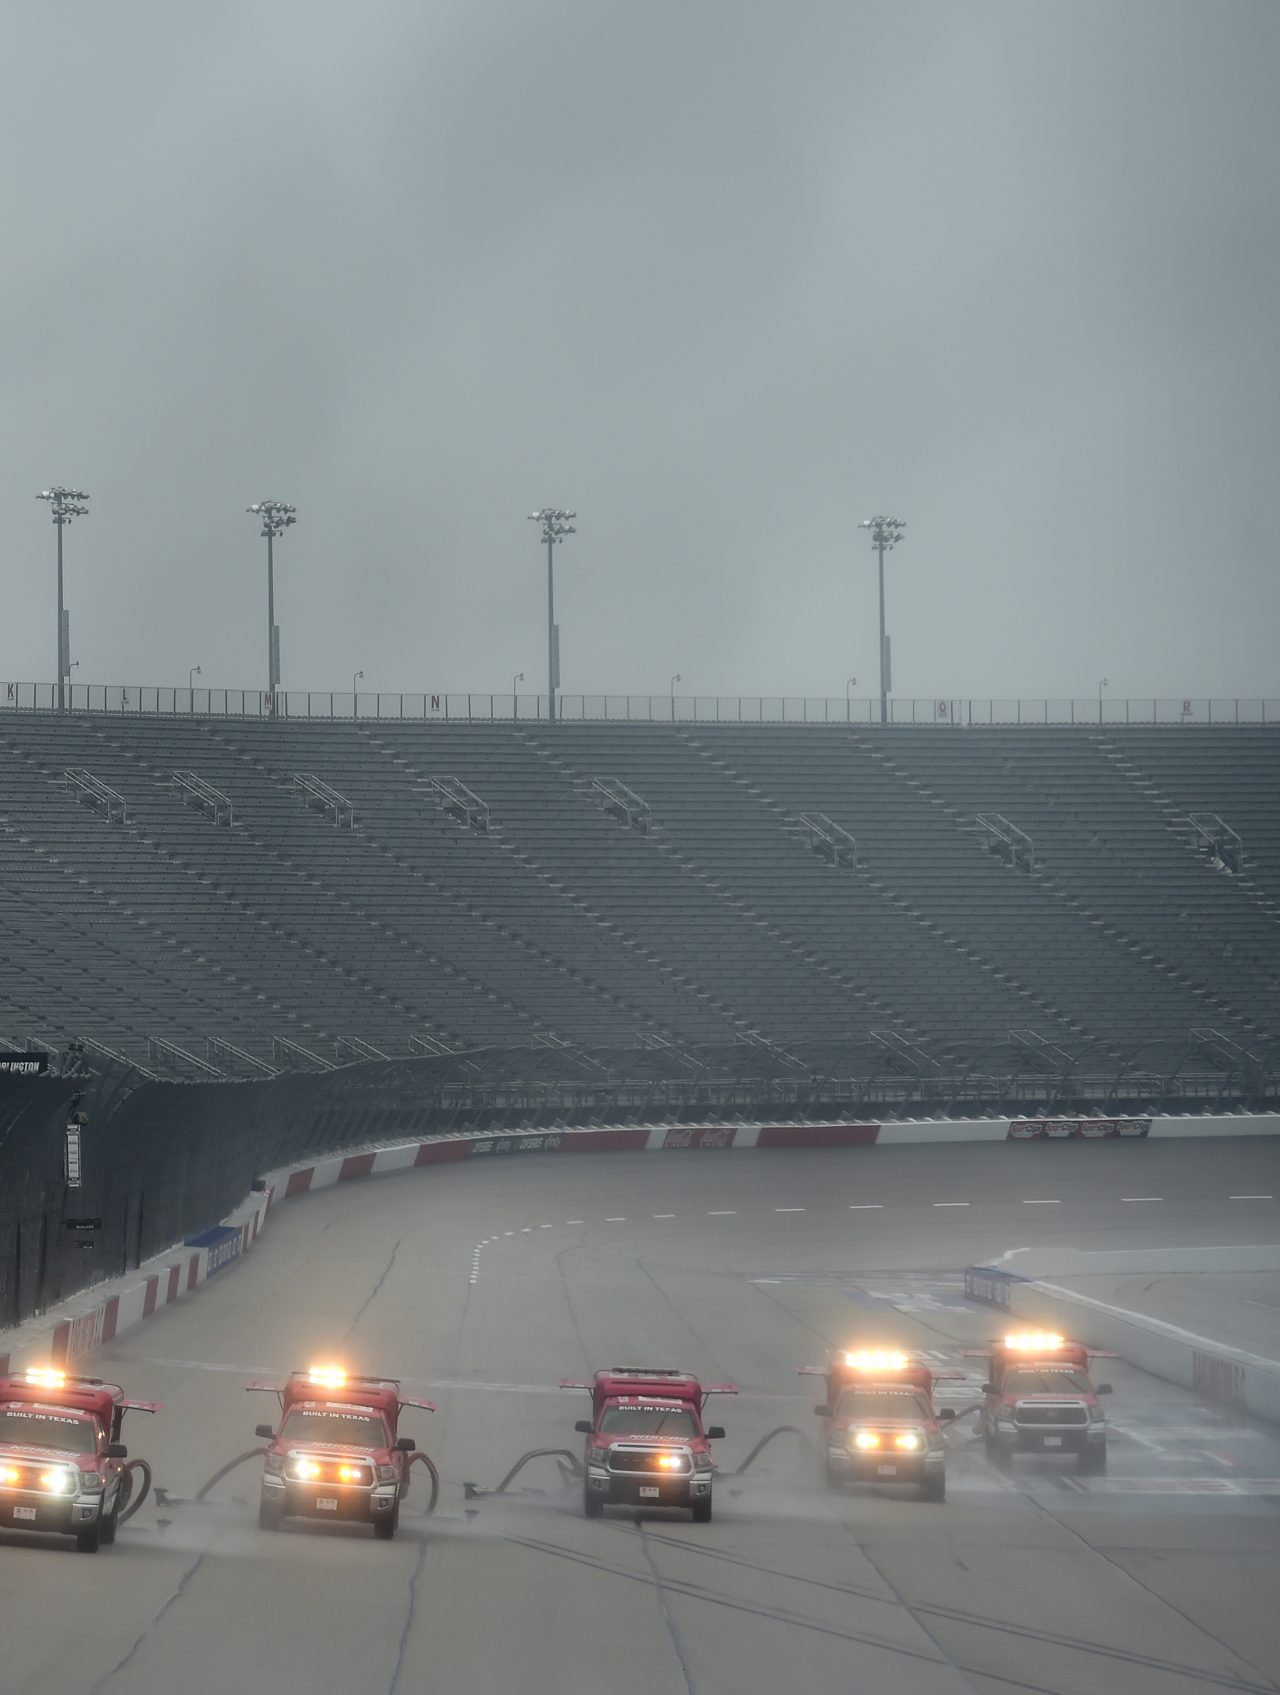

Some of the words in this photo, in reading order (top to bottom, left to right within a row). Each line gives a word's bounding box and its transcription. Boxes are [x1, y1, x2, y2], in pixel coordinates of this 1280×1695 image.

[7, 683, 14, 698] K
[122, 688, 128, 701] L
[264, 693, 272, 706] M
[431, 695, 439, 709] N
[1183, 701, 1191, 713] R
[48, 1415, 79, 1425] TEXAS
[341, 1413, 370, 1422] TEXAS
